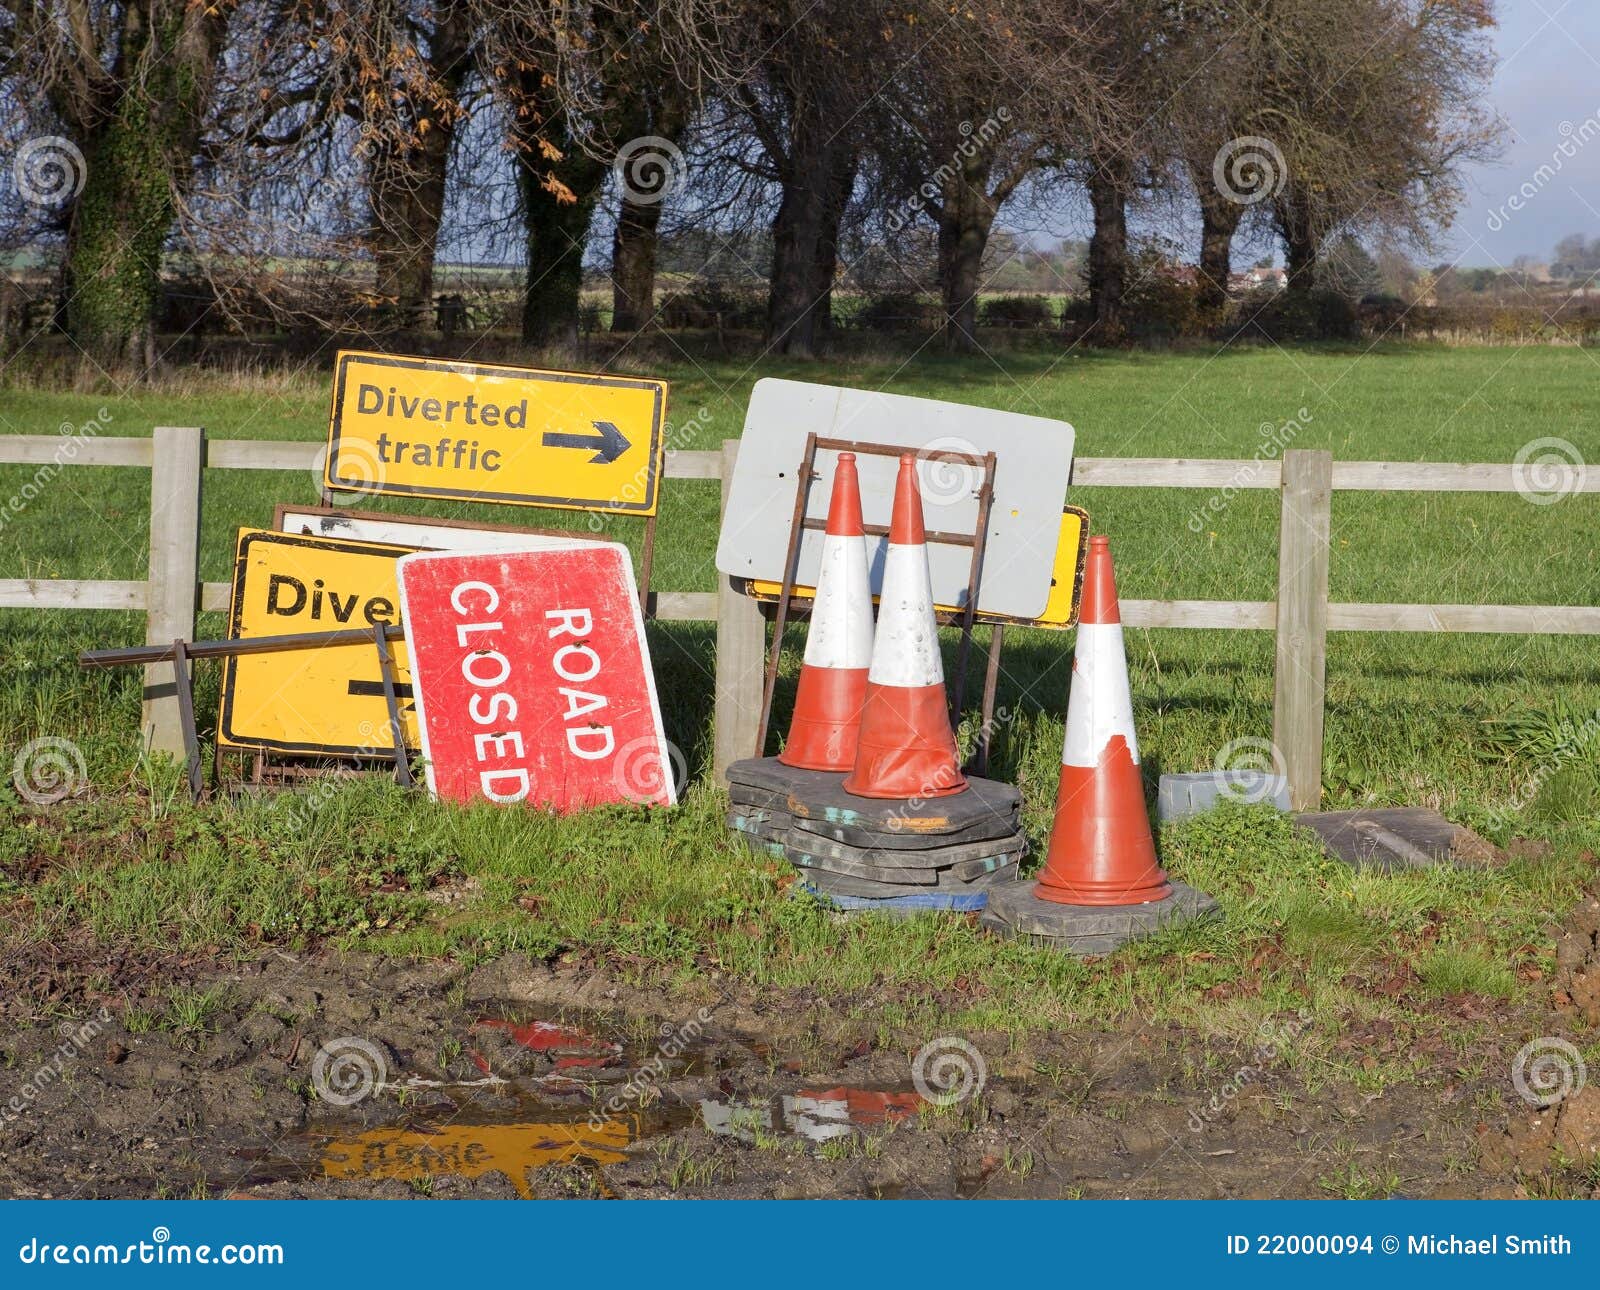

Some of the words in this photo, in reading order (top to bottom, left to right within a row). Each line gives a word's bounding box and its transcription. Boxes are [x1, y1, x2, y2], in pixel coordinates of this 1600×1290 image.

[357, 383, 528, 429] Diverted
[376, 432, 502, 472] traffic
[266, 573, 402, 626] Dive
[450, 580, 531, 803] CLOSED
[545, 608, 616, 760] ROAD
